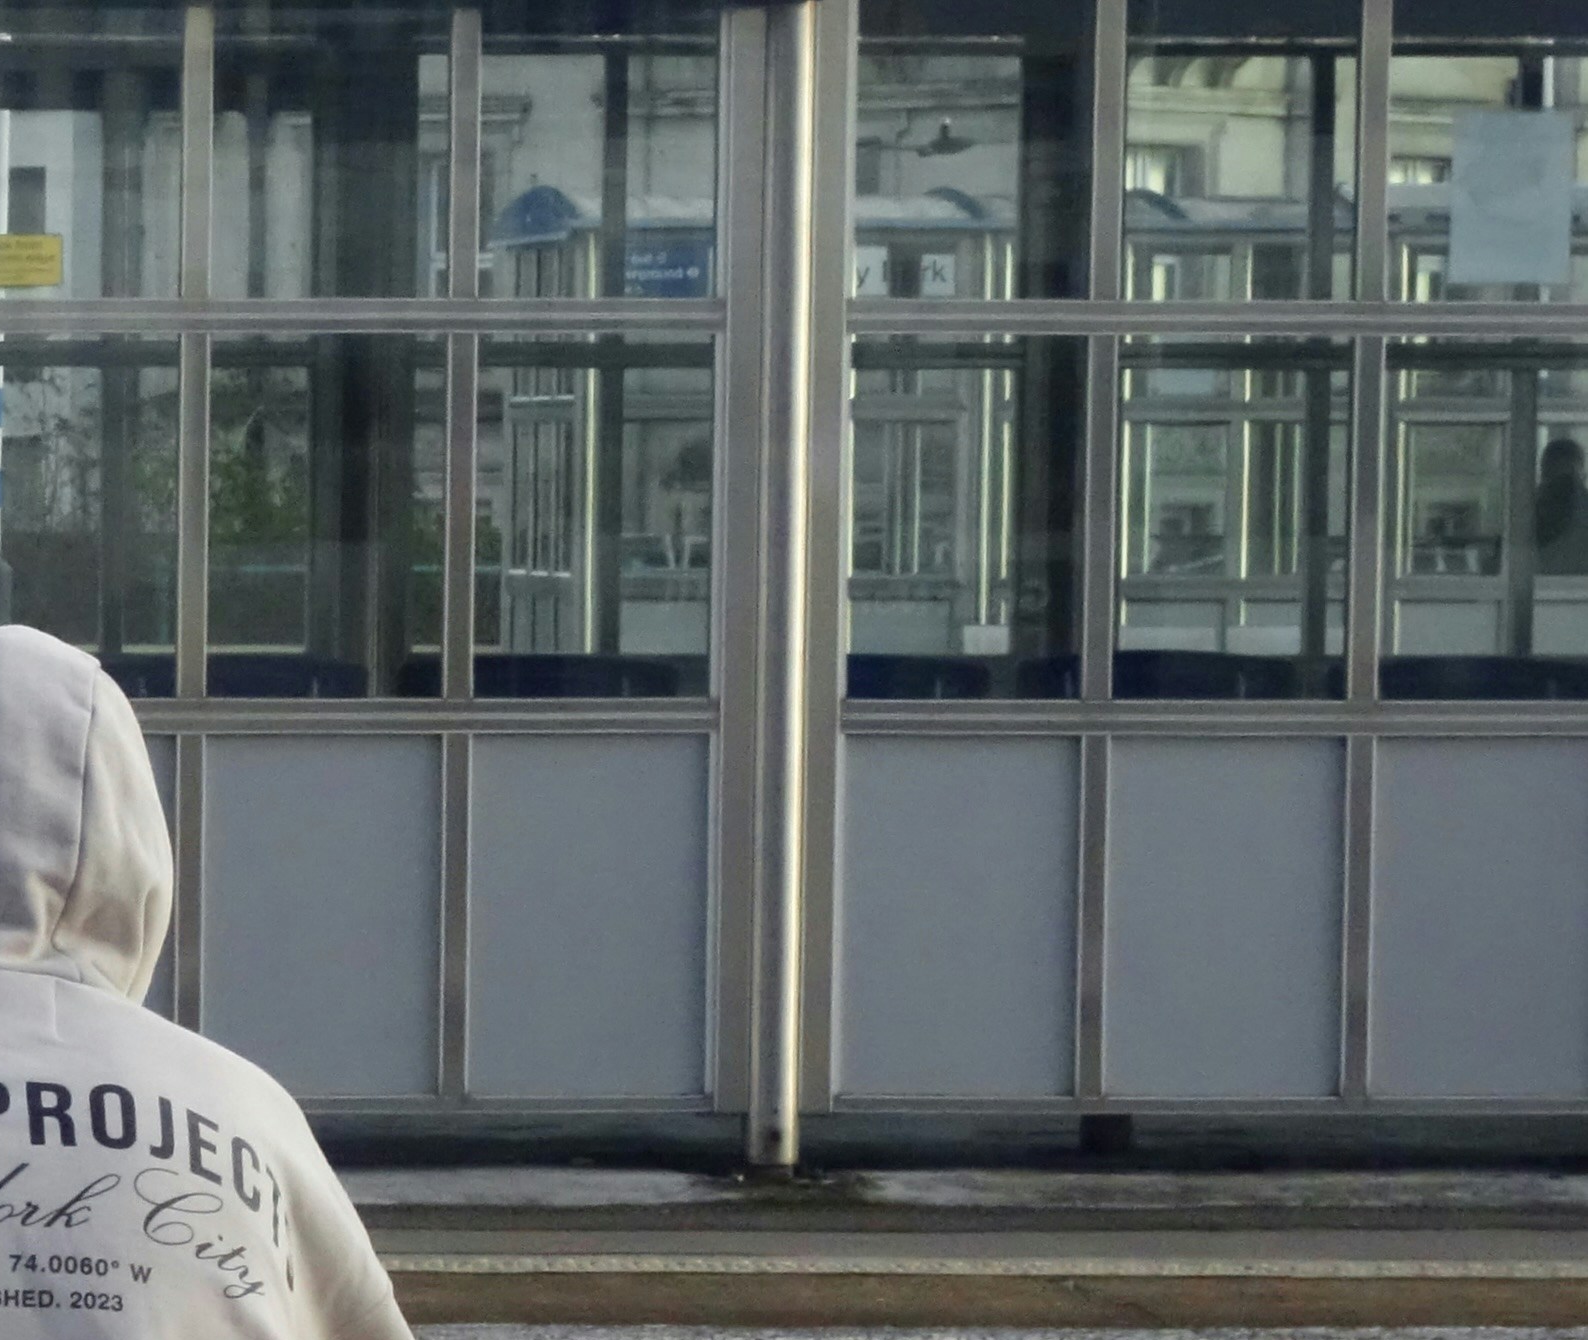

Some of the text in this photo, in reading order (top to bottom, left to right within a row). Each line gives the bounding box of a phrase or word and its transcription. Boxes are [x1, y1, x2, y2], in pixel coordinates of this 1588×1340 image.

[133, 1167, 266, 1300] City
[9, 1254, 120, 1277] 74.0060°
[130, 1263, 153, 1285] W
[69, 1291, 124, 1312] 2023
